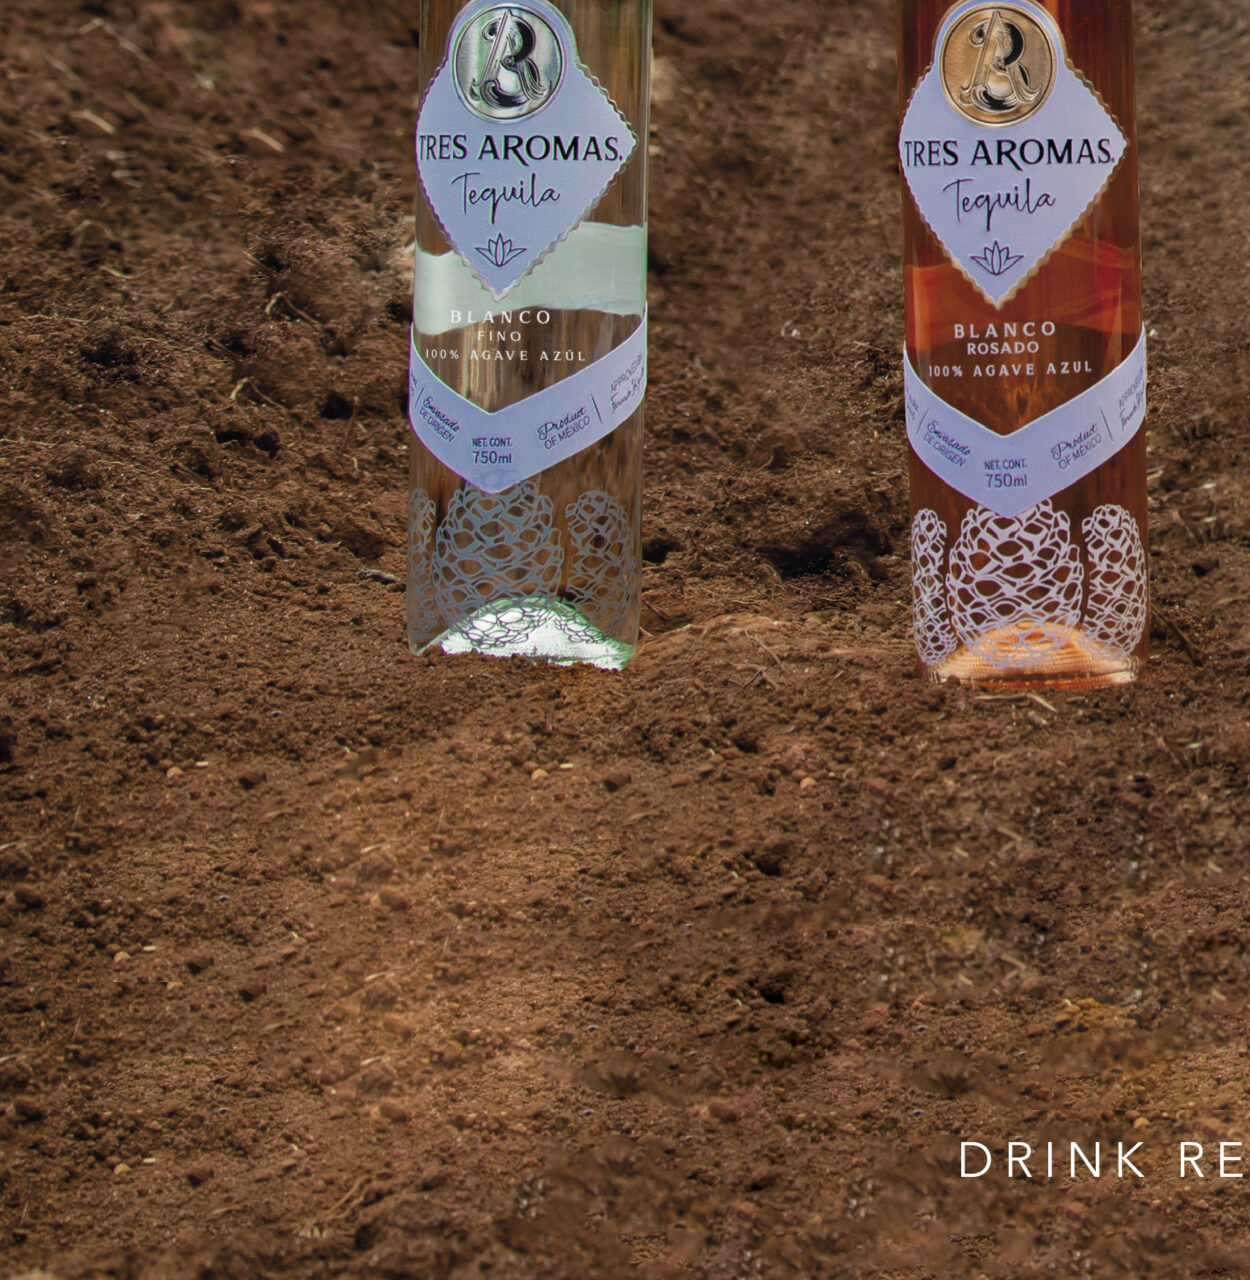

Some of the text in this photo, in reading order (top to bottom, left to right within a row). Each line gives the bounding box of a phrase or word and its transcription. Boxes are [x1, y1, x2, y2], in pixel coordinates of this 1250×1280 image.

[419, 135, 468, 161] TRES
[904, 140, 959, 167] TRES
[452, 172, 560, 224] Tequila
[943, 178, 1056, 232] Tequila
[450, 310, 551, 324] BLANCO
[477, 331, 522, 341] FINO
[954, 321, 1056, 339] BLANCO
[425, 349, 459, 359] 100%
[470, 350, 528, 361] AGAVE
[967, 341, 1040, 356] ROSADO
[929, 360, 1092, 377] 100% AGAVE AZUL
[423, 396, 461, 432] Envasado
[420, 408, 456, 442] DE ORIGEN
[537, 406, 587, 441] Product
[544, 437, 558, 450] OF
[923, 434, 966, 467] DE ORIGEN
[1051, 423, 1098, 462] Product
[472, 451, 512, 464] 750ml
[1058, 458, 1071, 470] OF
[985, 474, 1028, 488] 750ml
